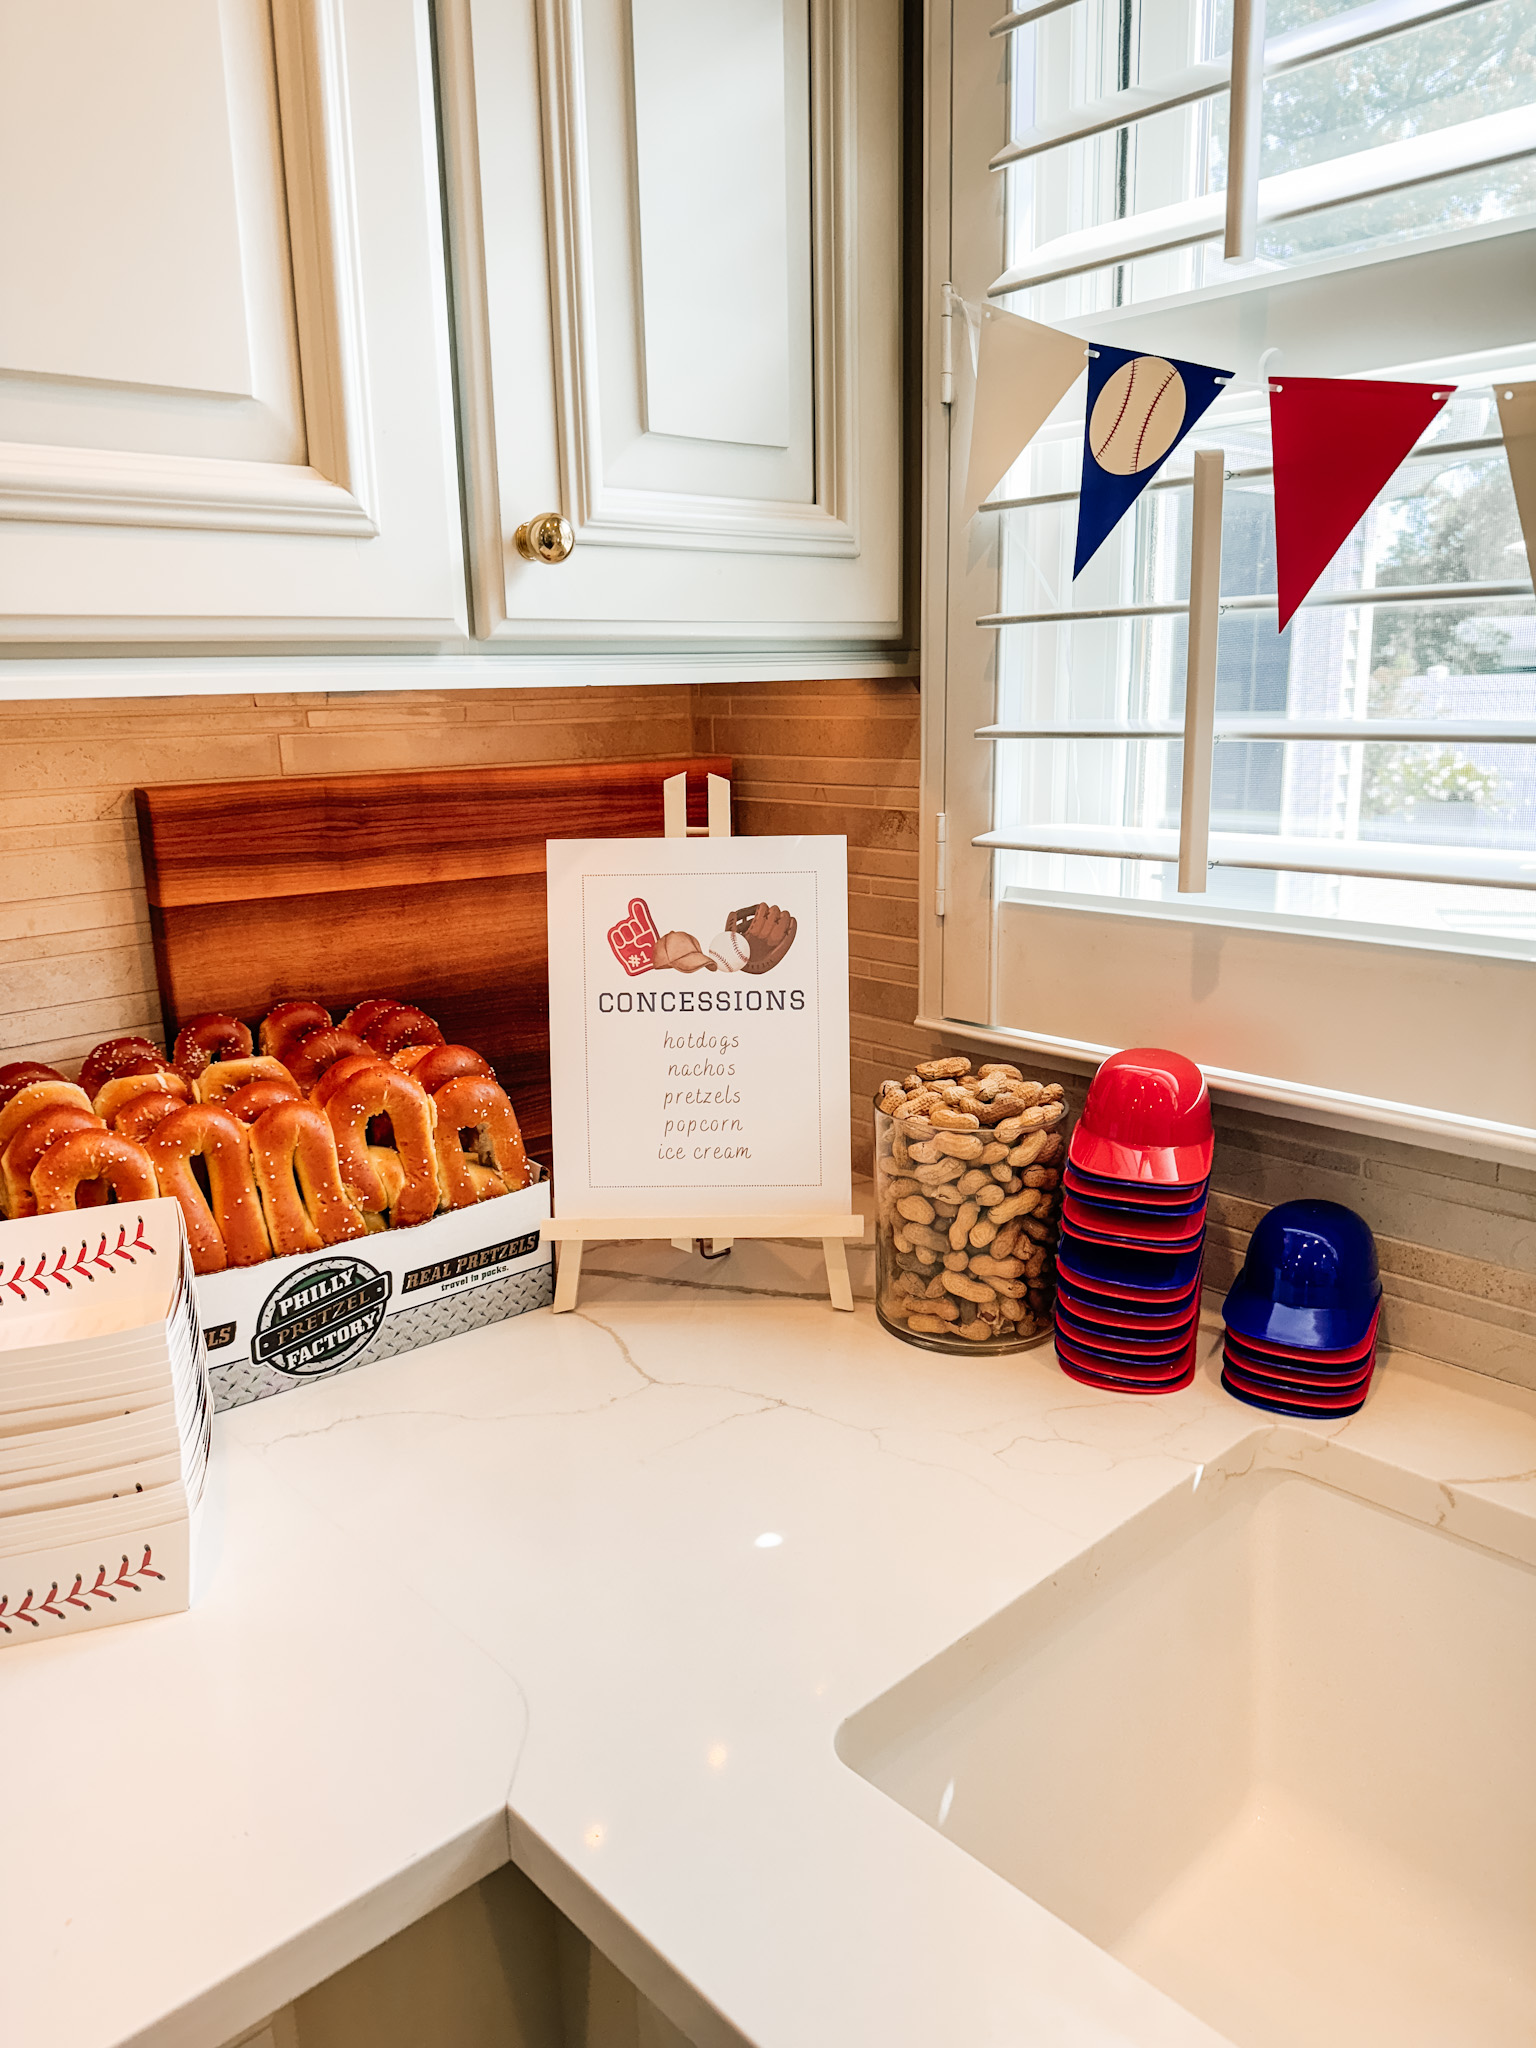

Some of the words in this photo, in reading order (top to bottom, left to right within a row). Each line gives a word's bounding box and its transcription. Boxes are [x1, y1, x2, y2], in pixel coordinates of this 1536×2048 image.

[628, 951, 651, 968] #1
[599, 989, 805, 1013] CONCESSIONS
[663, 1031, 739, 1055] hotdogs
[667, 1059, 736, 1077] nachos
[663, 1085, 741, 1109] pretzels
[664, 1116, 743, 1137] popcorn
[658, 1143, 686, 1160] ice
[693, 1145, 752, 1160] cream
[406, 1262, 452, 1290] REAL
[456, 1234, 537, 1273] PRETZELS
[278, 1266, 355, 1317] PHILLY
[441, 1276, 469, 1291] travel
[470, 1273, 479, 1282] in
[277, 1289, 371, 1347] PRETZEL
[285, 1310, 378, 1370] FACTORY
